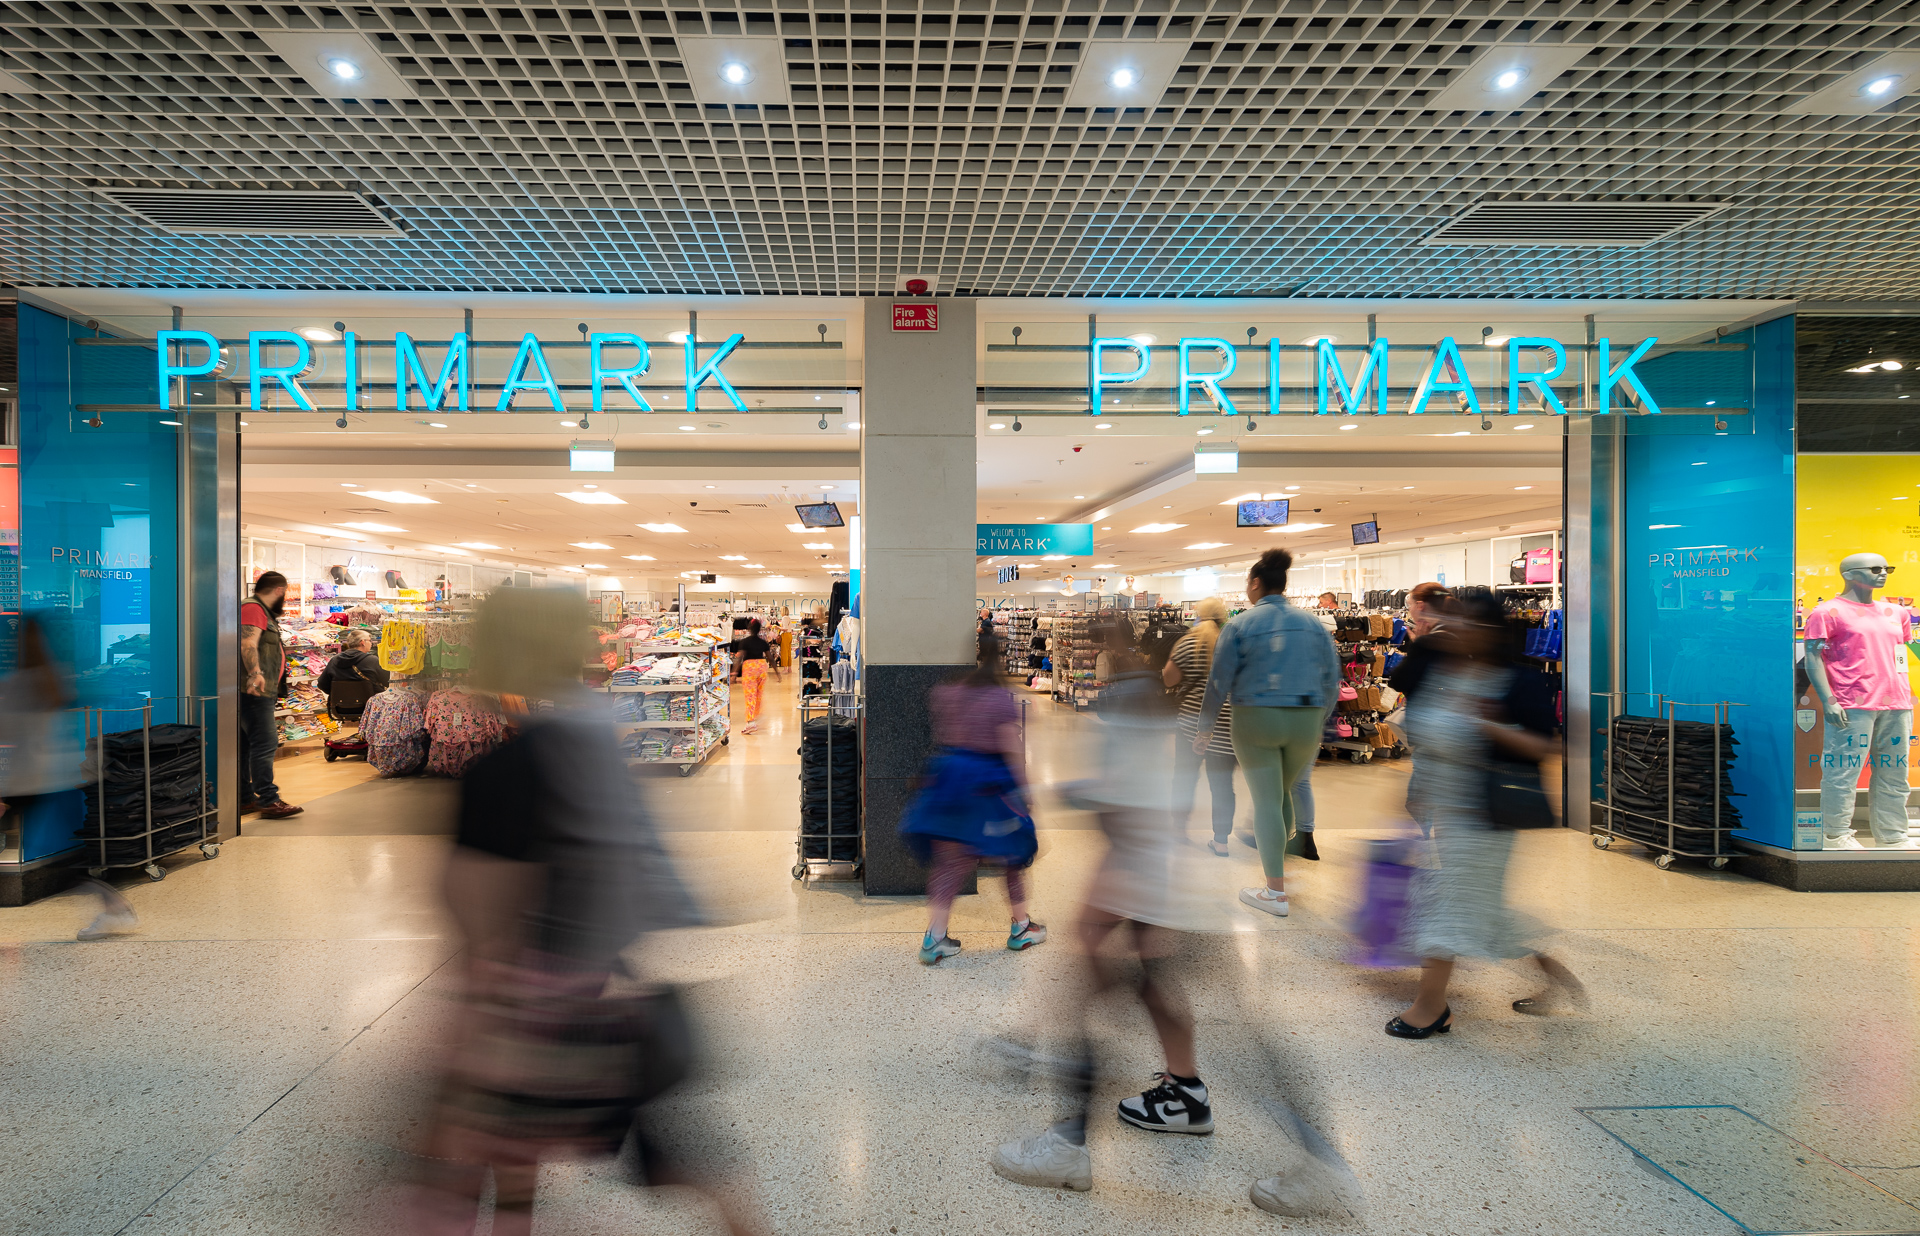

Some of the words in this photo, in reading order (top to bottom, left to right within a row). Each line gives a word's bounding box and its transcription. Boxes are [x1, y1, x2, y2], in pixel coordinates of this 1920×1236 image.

[895, 307, 915, 317] Fire
[895, 318, 925, 327] alarm
[157, 330, 749, 413] PRIMARK
[1090, 336, 1662, 416] PRIMARK
[990, 528, 1015, 537] WELCOME
[1017, 528, 1026, 537] TO
[977, 538, 1047, 550] RIMARK
[51, 546, 154, 570] PRIMARK
[1648, 546, 1759, 568] PRIMARK
[79, 569, 133, 580] MANSFIELD
[997, 565, 1018, 584] SHOES
[1673, 567, 1730, 579] MANSFIELD
[1808, 753, 1920, 769] PRIMARK.
